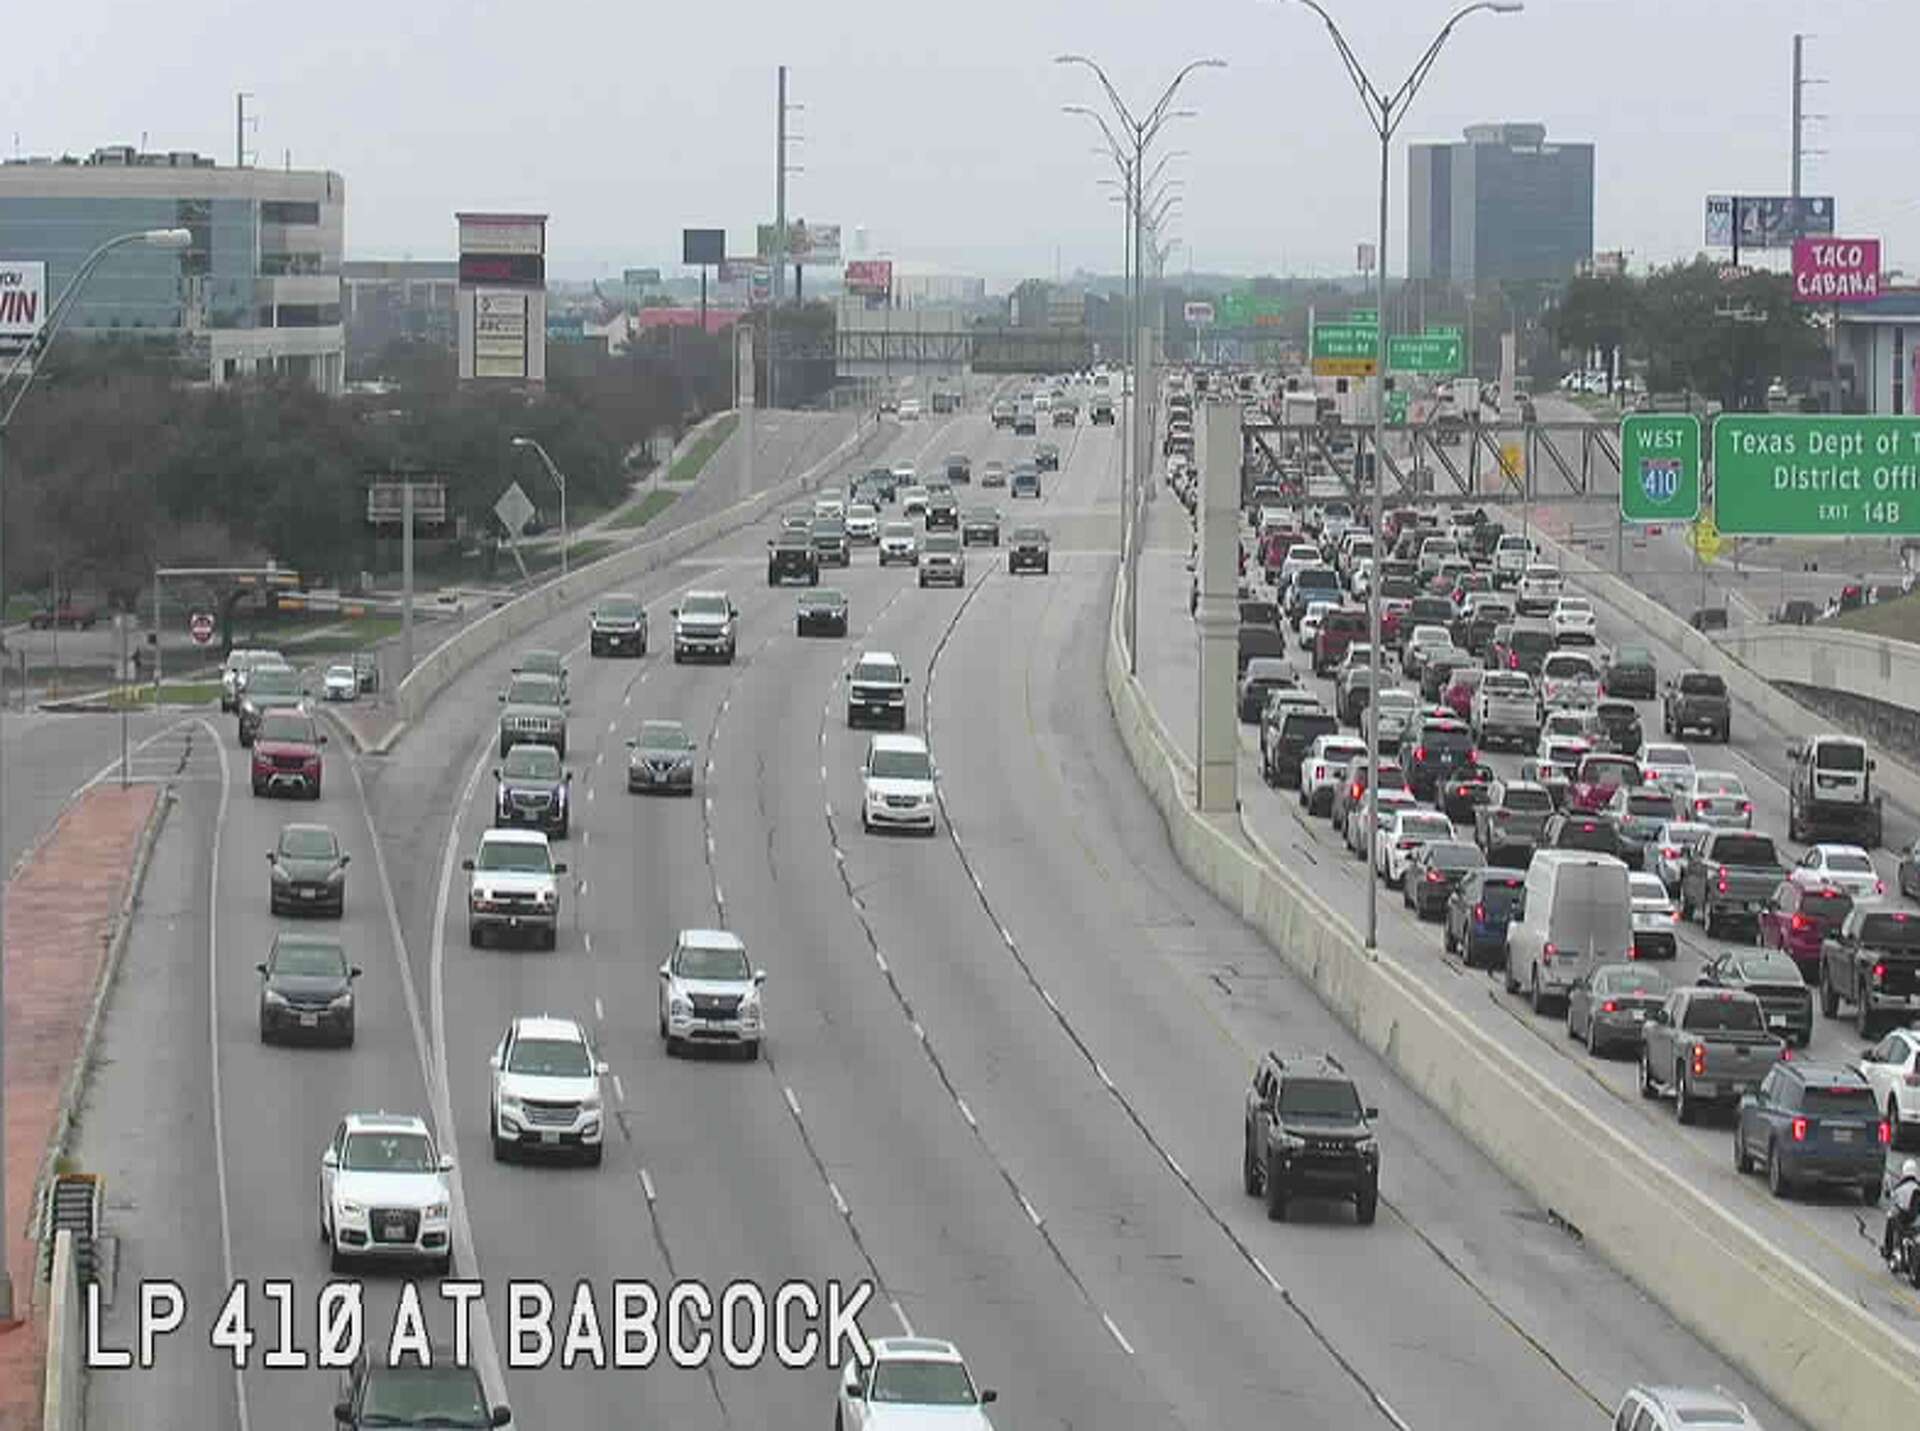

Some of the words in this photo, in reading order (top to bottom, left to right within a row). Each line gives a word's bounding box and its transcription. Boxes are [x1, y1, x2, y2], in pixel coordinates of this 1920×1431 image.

[1811, 245, 1863, 267] TACO
[1797, 270, 1877, 296] CABANA
[1636, 429, 1683, 448] WEST
[1729, 430, 1795, 454] Texas
[1809, 430, 1864, 460] Dept
[1876, 429, 1899, 454] of
[1645, 470, 1677, 495] 410
[1774, 465, 1860, 490] District
[1873, 464, 1920, 490] Offi
[1819, 505, 1848, 520] EXIT
[1863, 501, 1900, 523] 14B
